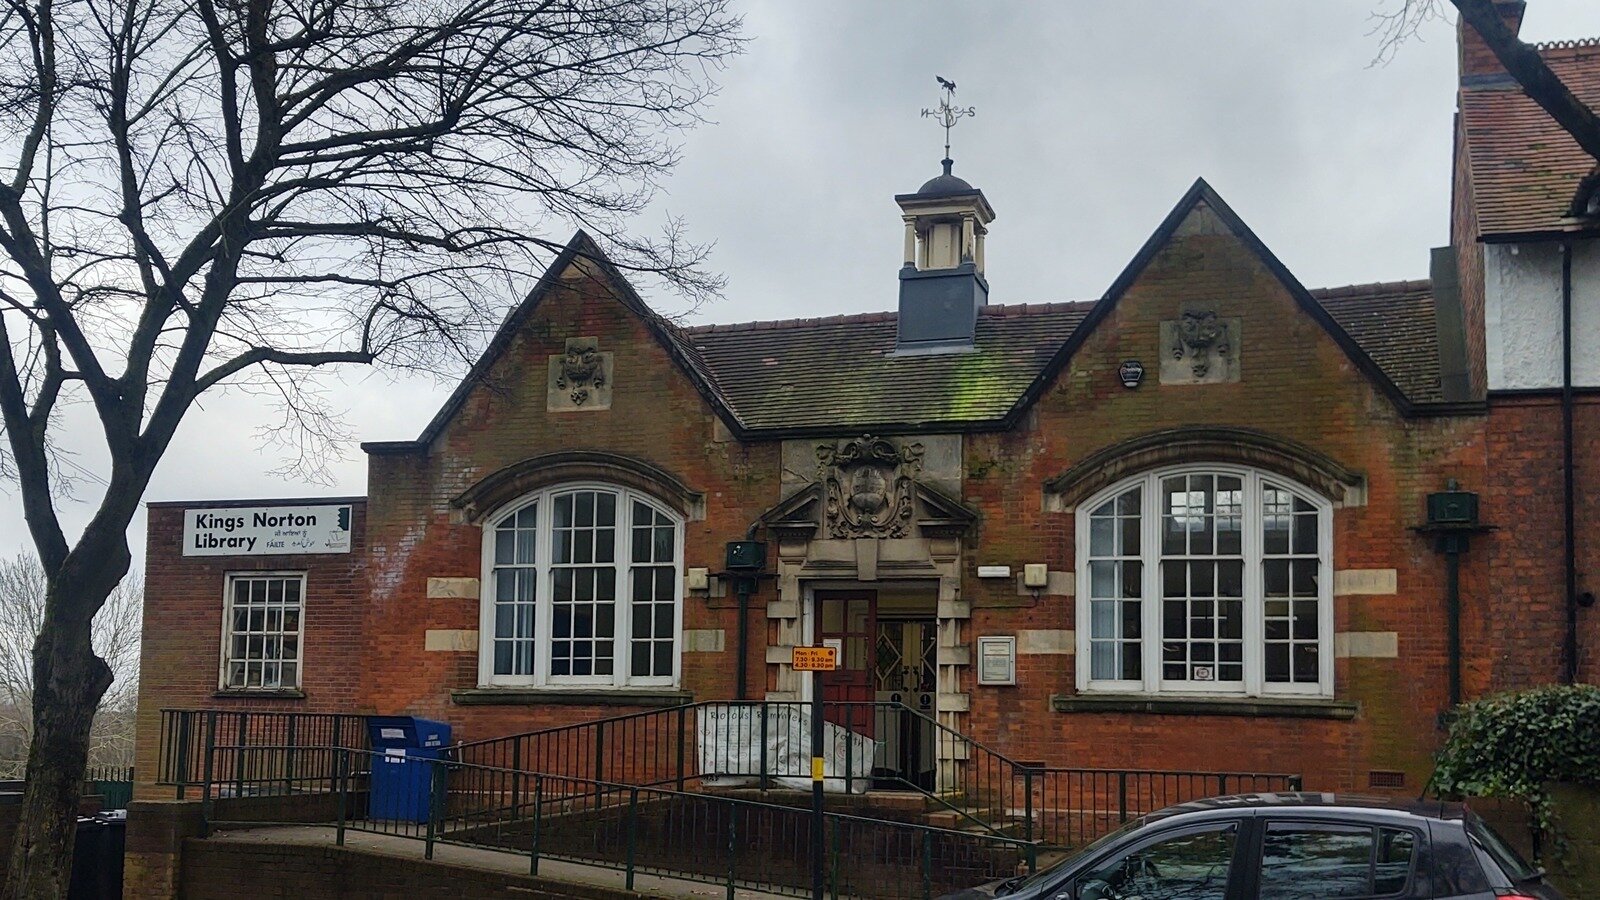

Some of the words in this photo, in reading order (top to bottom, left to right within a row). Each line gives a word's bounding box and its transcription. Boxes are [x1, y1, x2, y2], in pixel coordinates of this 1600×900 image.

[196, 513, 244, 532] Kings
[253, 512, 316, 528] Norton
[195, 533, 257, 551] Library
[266, 539, 285, 548] FÁILTE
[711, 711, 749, 720] Roous
[834, 730, 863, 746] Yoth
